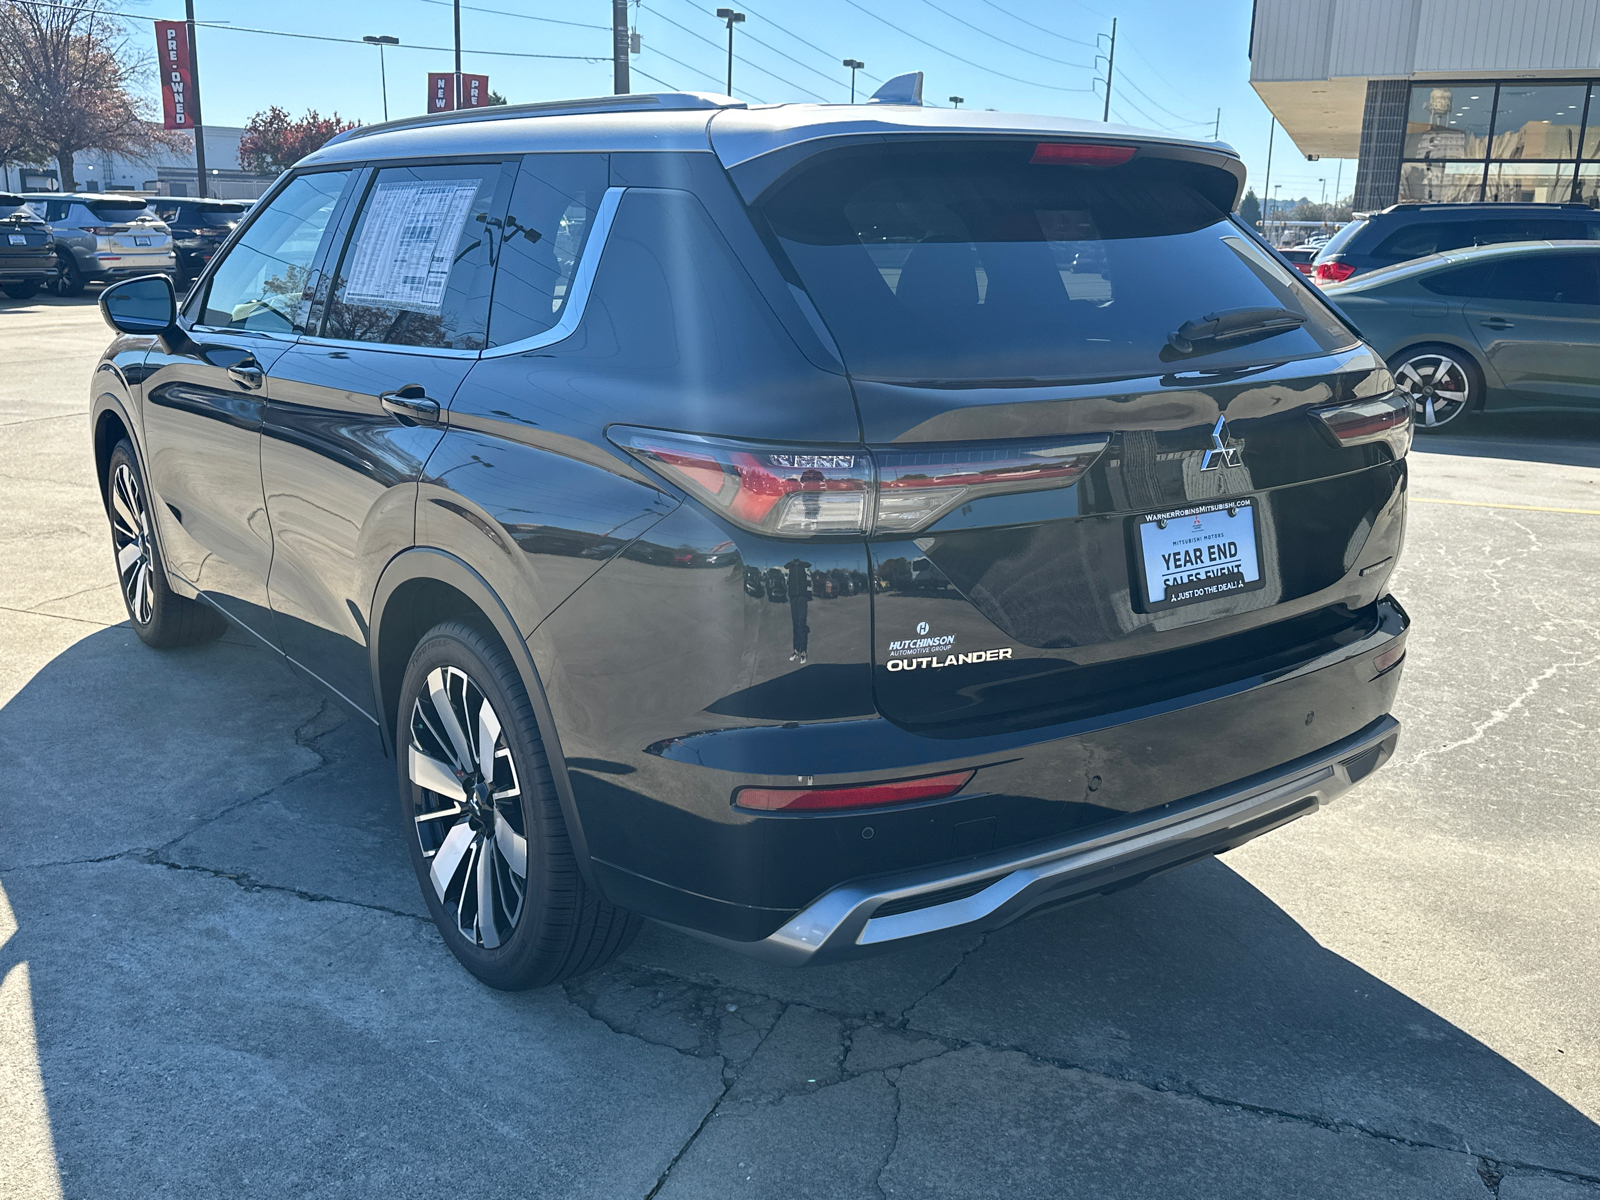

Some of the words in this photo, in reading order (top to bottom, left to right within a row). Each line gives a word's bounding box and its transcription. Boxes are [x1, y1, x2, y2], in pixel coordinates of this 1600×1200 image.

[166, 29, 185, 124] PRE-OWNED
[435, 79, 446, 108] NEW
[470, 80, 479, 105] PRE
[1172, 536, 1202, 546] MITSUBISHI
[1203, 532, 1224, 540] MOTORS
[1161, 547, 1204, 571] YEAR
[1207, 541, 1238, 562] END
[1178, 590, 1193, 601] JUST
[1194, 589, 1204, 597] DO
[1204, 585, 1218, 595] THE
[1218, 581, 1238, 592] DEAL!
[889, 634, 955, 650] HUTCHINSON
[890, 647, 930, 656] AUTOMOTIVE
[931, 644, 952, 653] GROUP
[886, 647, 1013, 672] OUTLANDER
